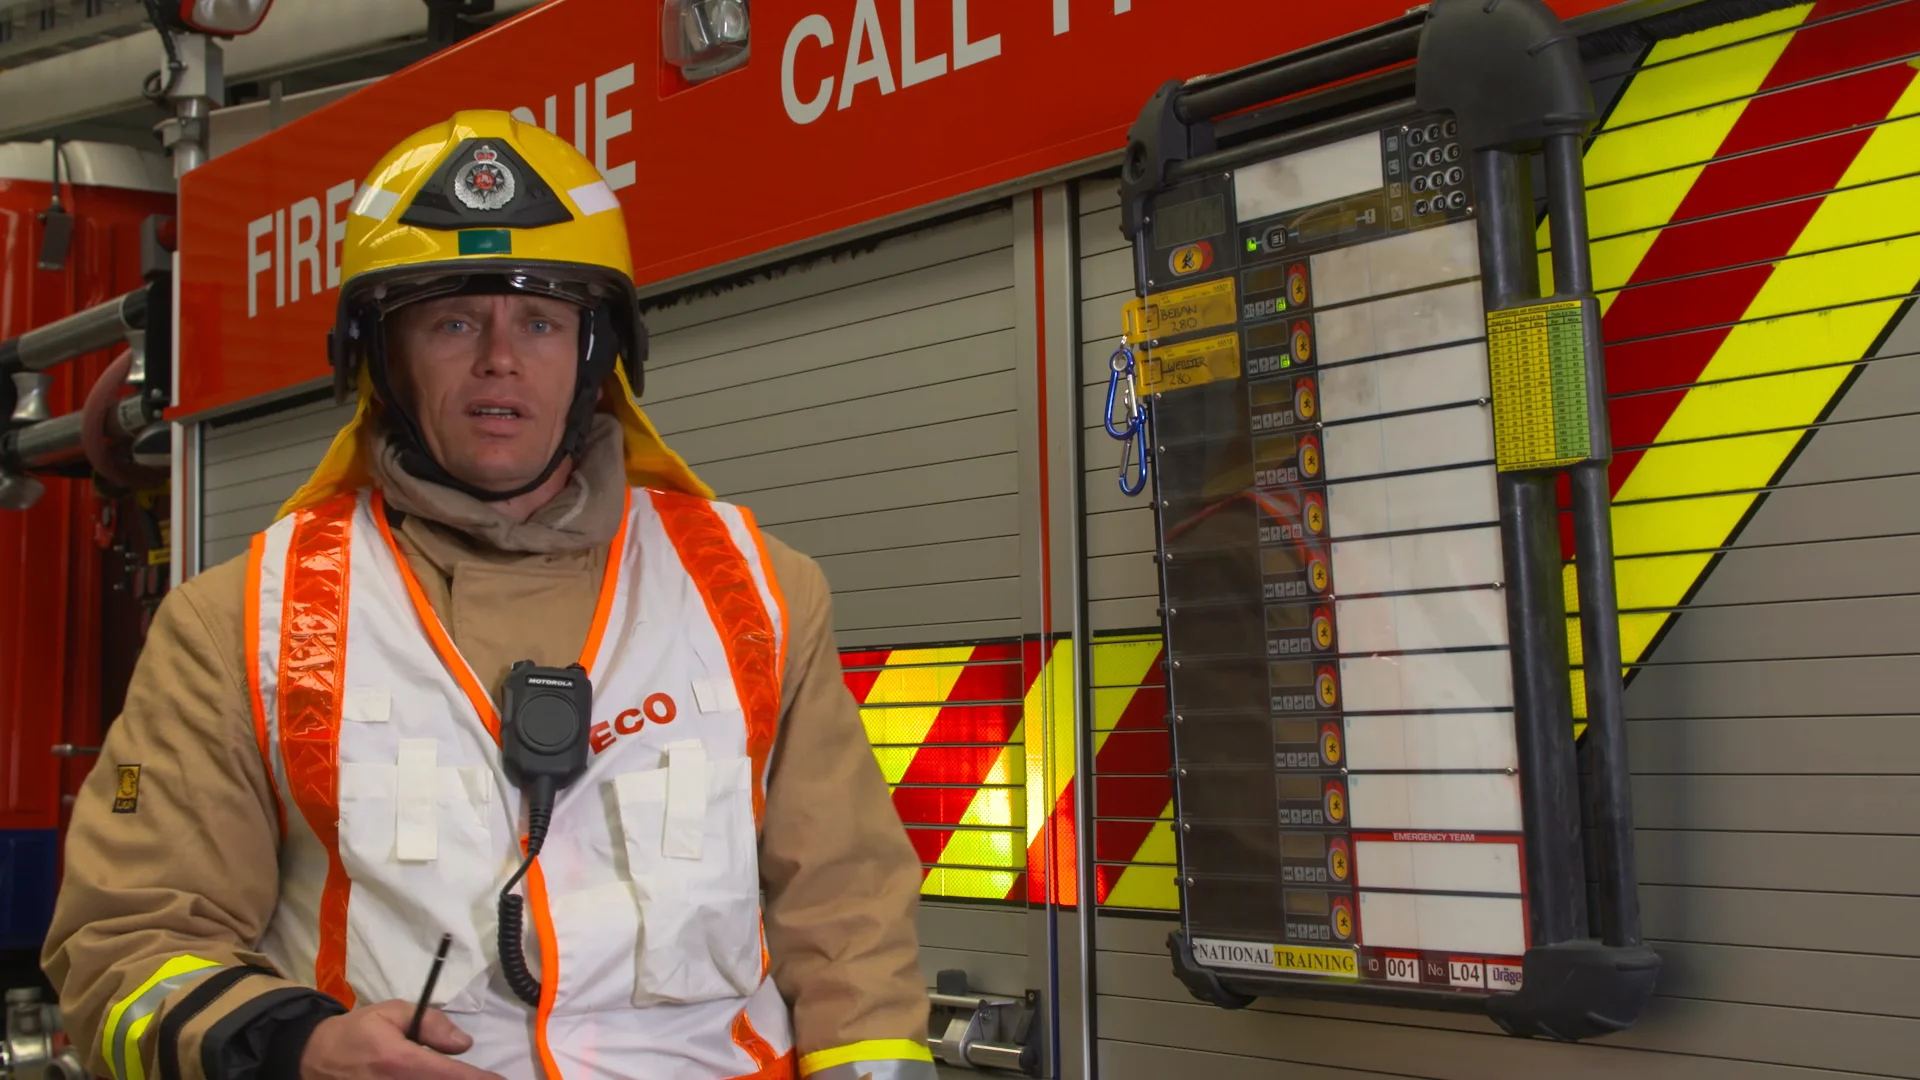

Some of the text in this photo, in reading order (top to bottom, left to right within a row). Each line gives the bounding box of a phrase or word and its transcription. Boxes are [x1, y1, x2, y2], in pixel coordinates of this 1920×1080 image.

[781, 0, 1001, 125] CALL
[248, 180, 356, 318] FIRE
[1170, 317, 1198, 332] 280
[528, 677, 573, 687] MOTOROLA
[589, 692, 677, 755] ECO
[1393, 832, 1475, 842] EMERGENCY TEAM
[1199, 943, 1354, 972] NATIONAL TRAINING
[1368, 958, 1415, 979] ID 001
[1427, 963, 1480, 982] No. L04
[1492, 966, 1523, 985] Dräge
